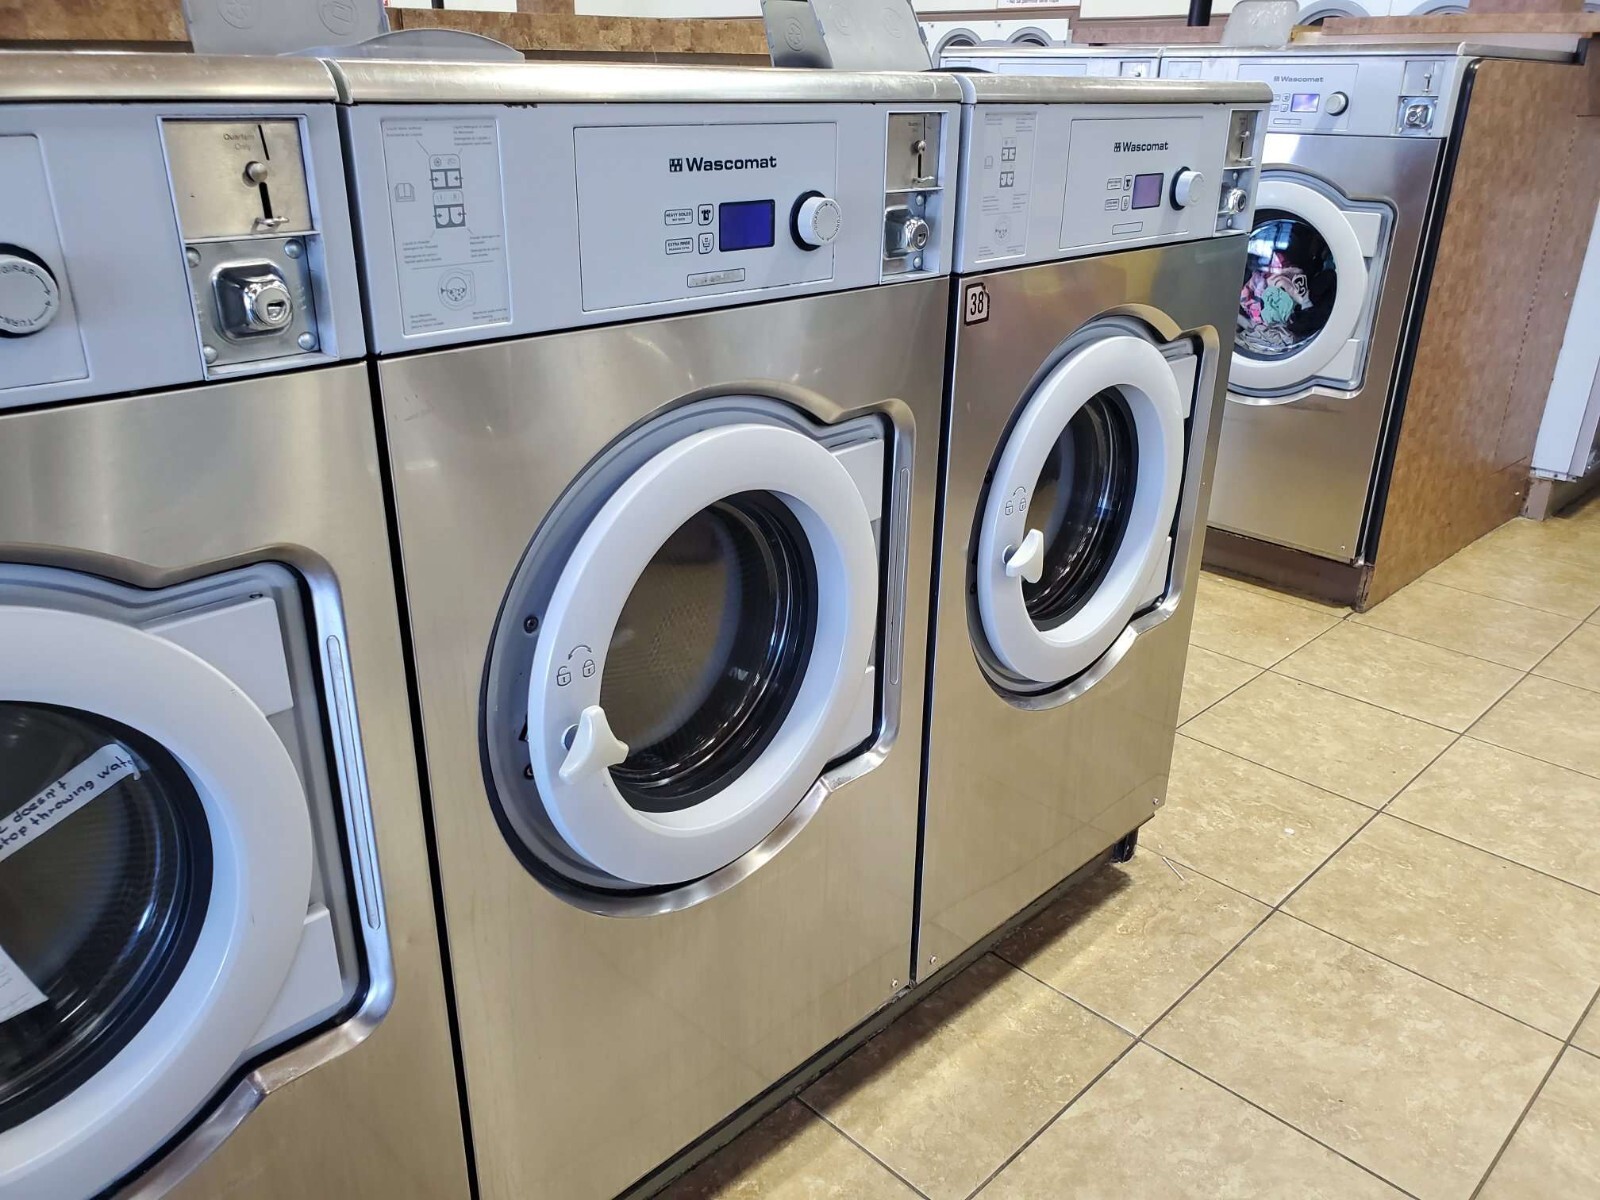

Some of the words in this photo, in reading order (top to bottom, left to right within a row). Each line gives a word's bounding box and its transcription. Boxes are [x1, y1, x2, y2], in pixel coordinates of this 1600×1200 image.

[1122, 141, 1169, 153] Wascomat
[686, 155, 777, 172] Wascomat
[970, 290, 985, 316] 38
[30, 780, 95, 826] throwing
